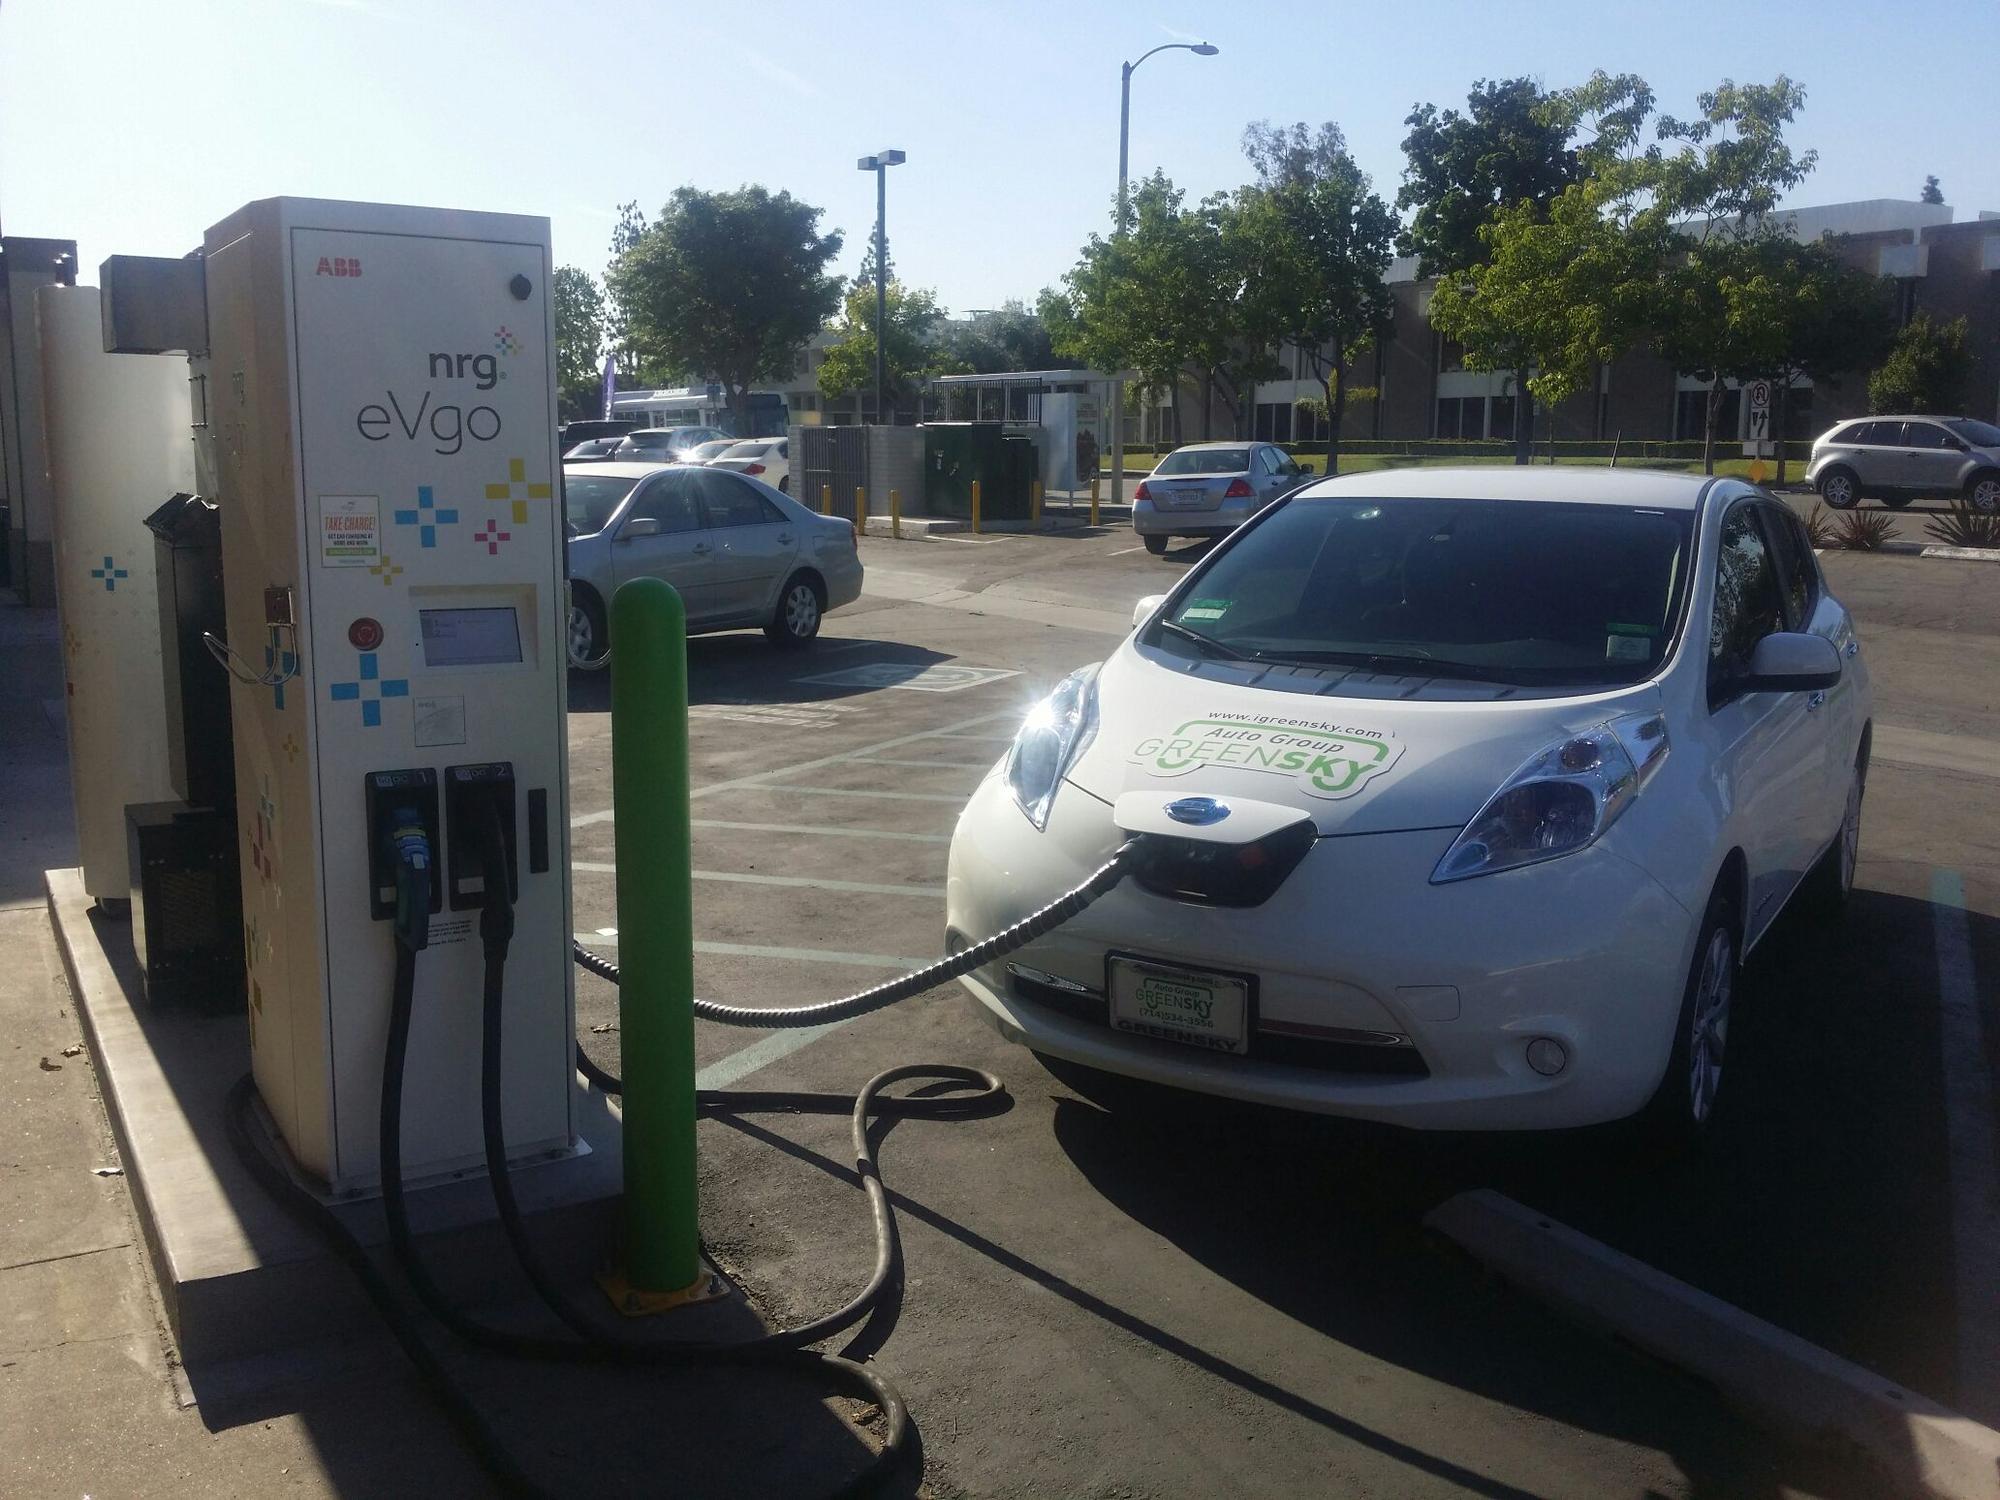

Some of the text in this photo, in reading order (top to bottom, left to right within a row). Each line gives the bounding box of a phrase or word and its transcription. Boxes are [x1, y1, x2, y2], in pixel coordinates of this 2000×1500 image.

[316, 257, 362, 277] ABB
[429, 352, 497, 389] nrg
[357, 391, 501, 454] eVgo
[325, 516, 376, 530] TAKE CHARGE!
[1208, 710, 1383, 739] www.igreensky.com
[1204, 727, 1345, 755] Auto Group
[1134, 737, 1378, 792] GREENSKY
[1136, 988, 1213, 1019] GREENSKY
[1154, 983, 1200, 998] Auto Group
[1117, 1019, 1238, 1051] GREENSKY
